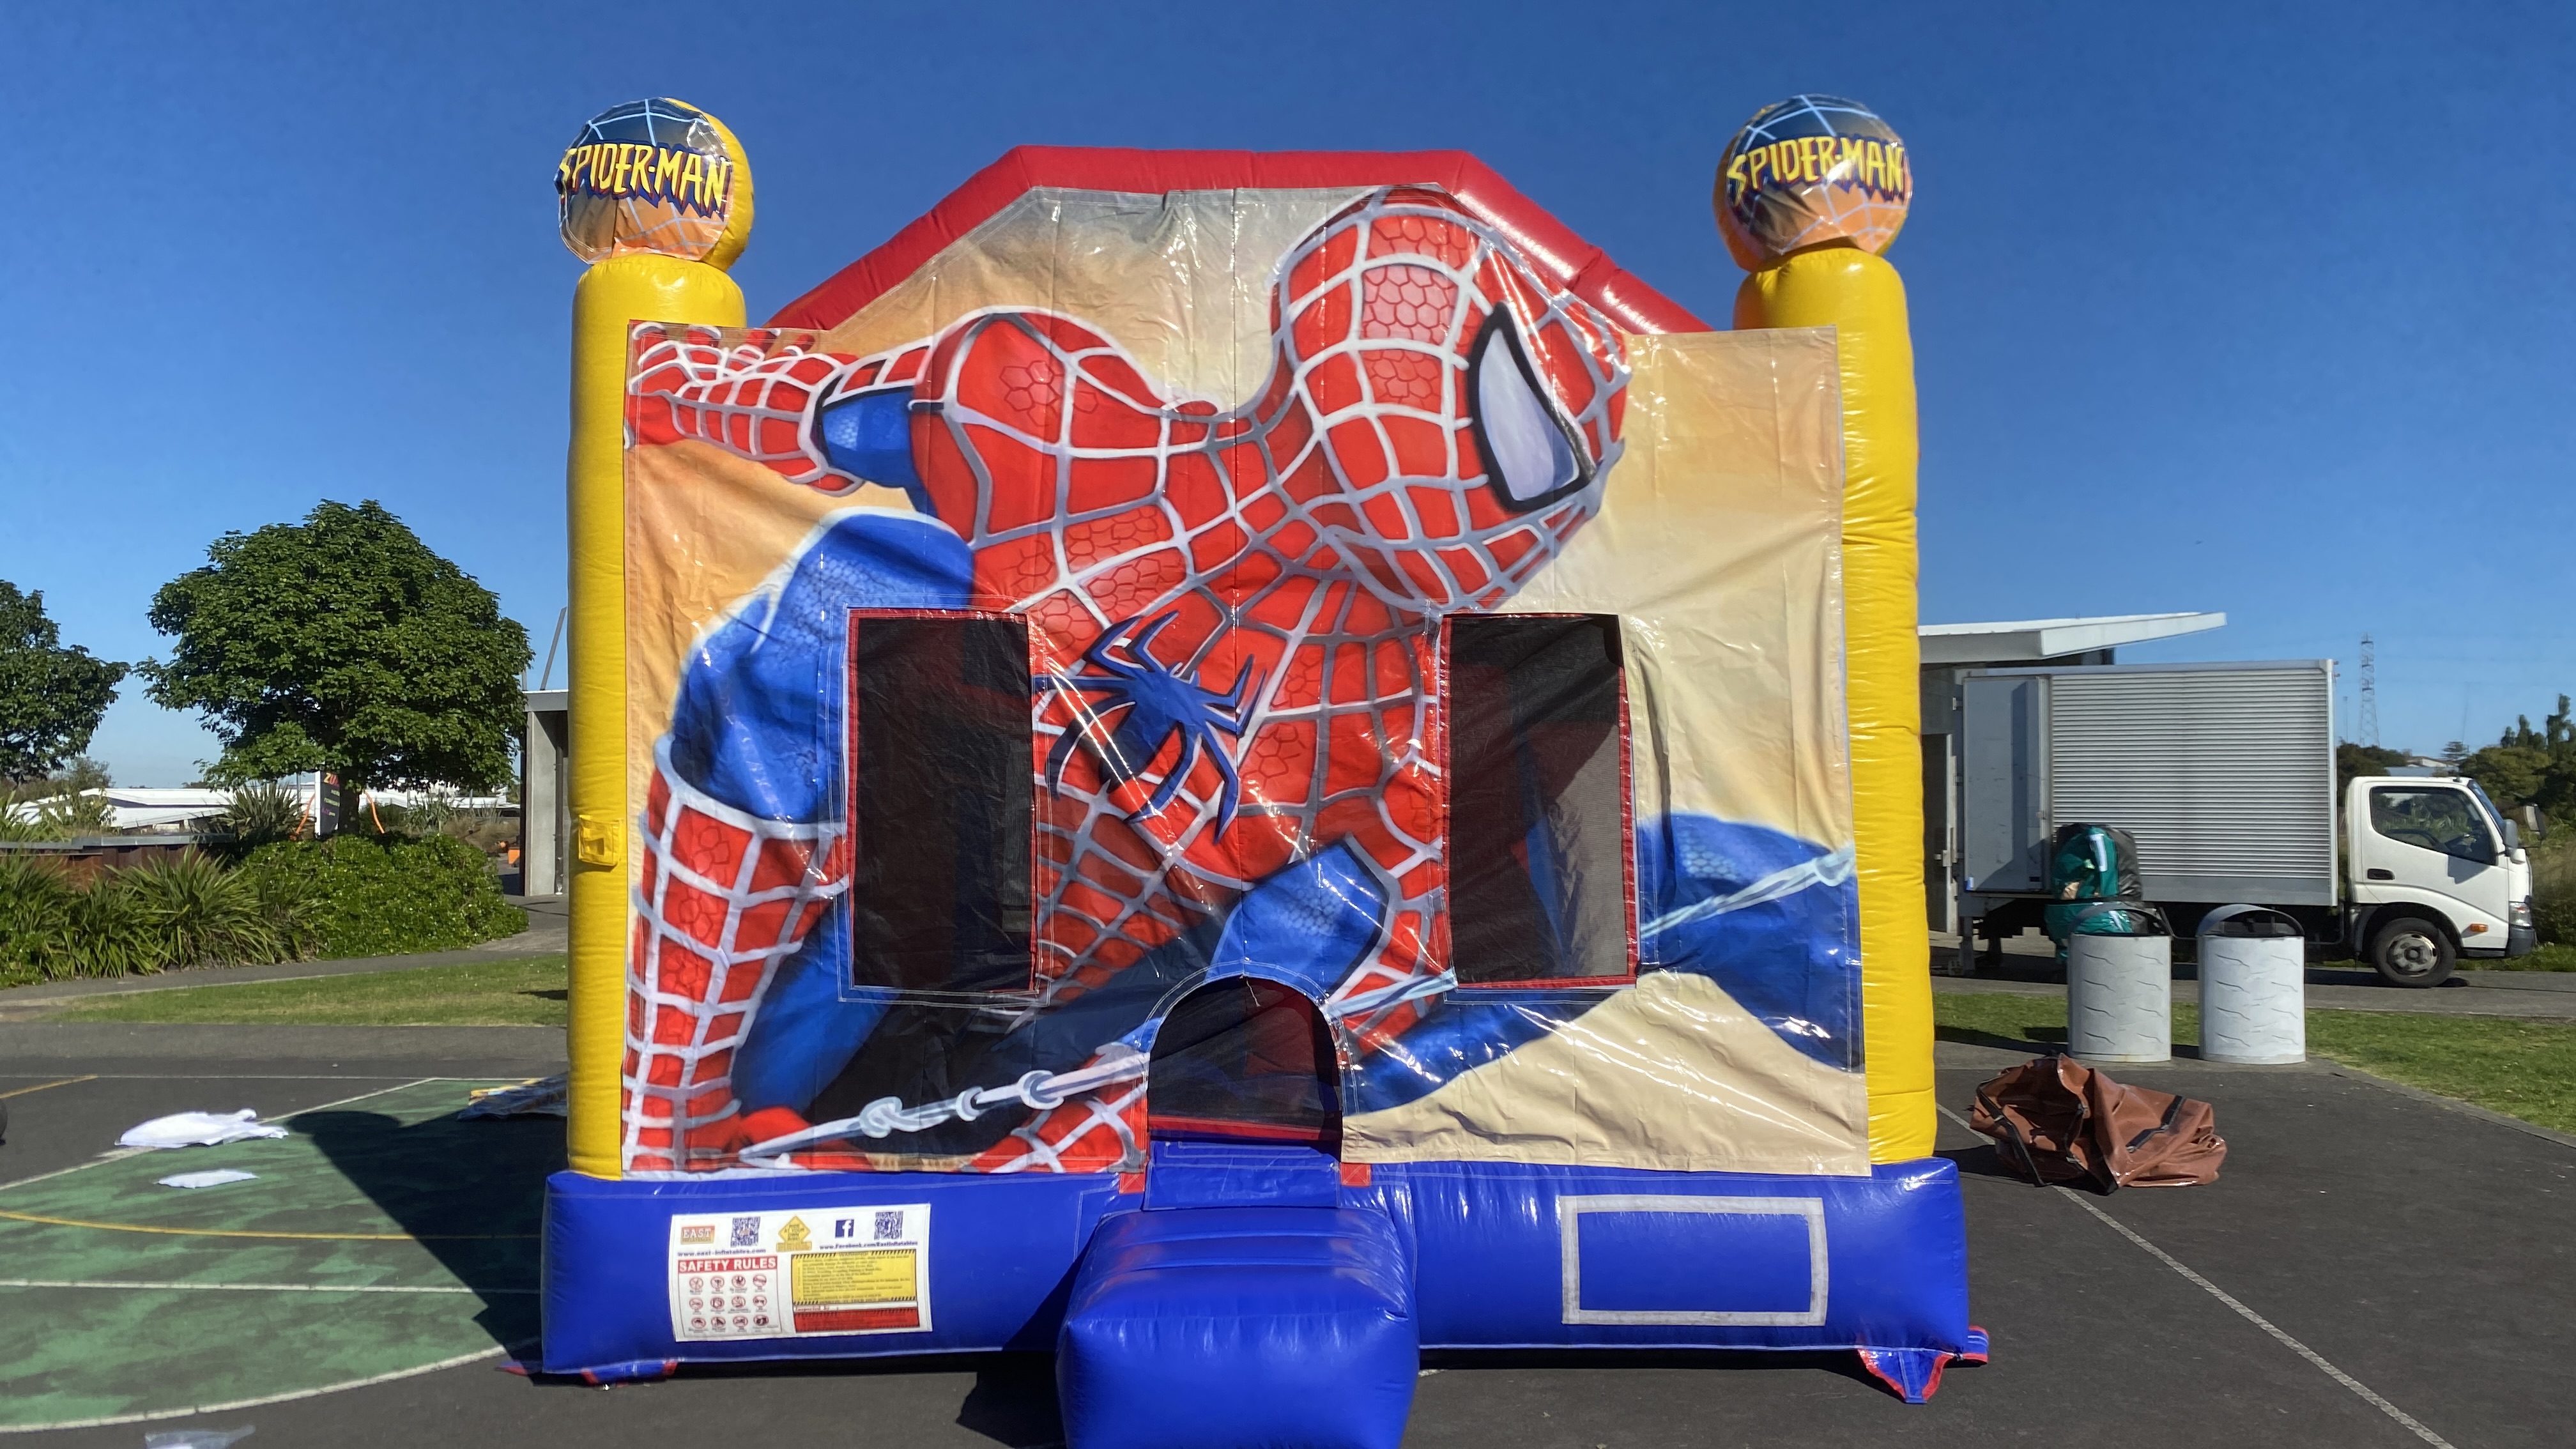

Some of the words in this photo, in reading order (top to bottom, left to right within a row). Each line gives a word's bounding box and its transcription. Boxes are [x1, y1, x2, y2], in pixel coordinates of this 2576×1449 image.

[558, 142, 733, 212] SPIDER-MAN
[1727, 135, 1905, 206] SPIDER-MAN
[683, 1228, 712, 1239] EAST
[679, 1259, 730, 1272] SAFETY
[734, 1257, 776, 1270] RULES
